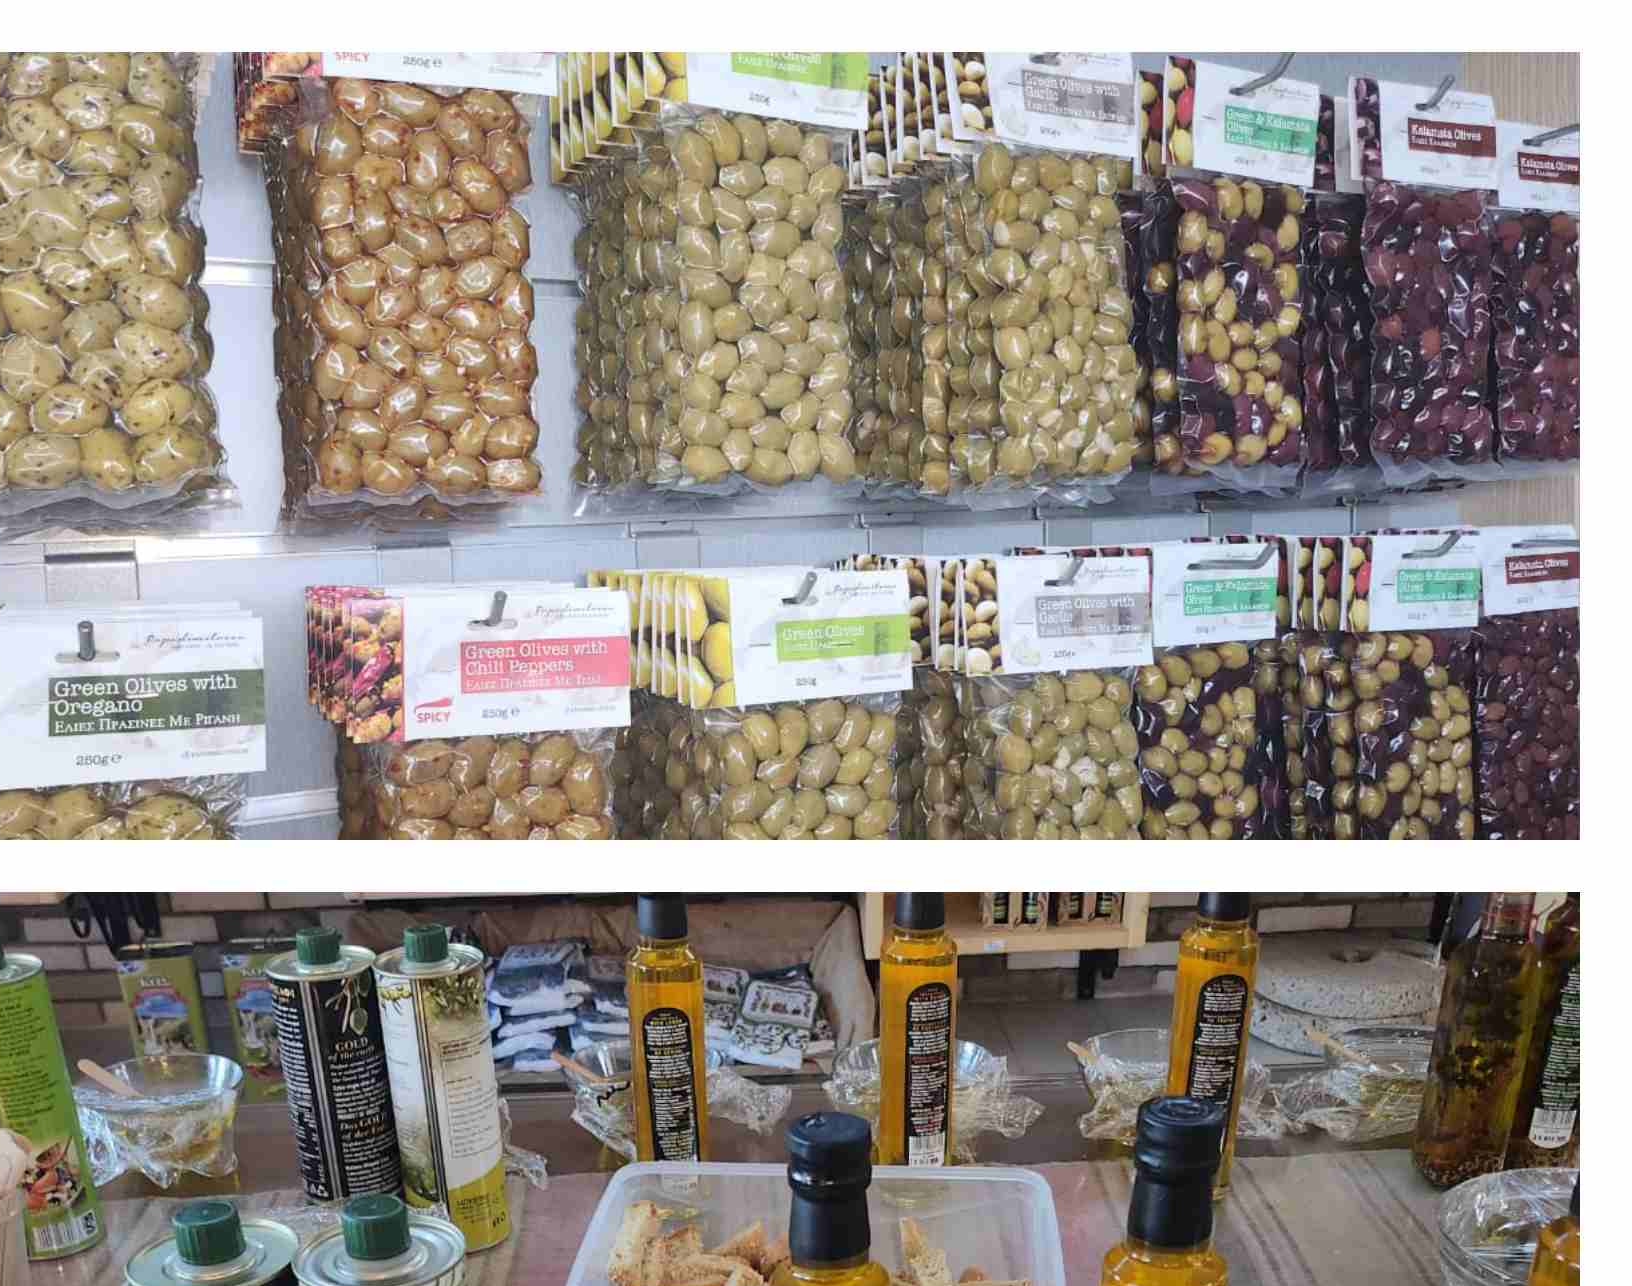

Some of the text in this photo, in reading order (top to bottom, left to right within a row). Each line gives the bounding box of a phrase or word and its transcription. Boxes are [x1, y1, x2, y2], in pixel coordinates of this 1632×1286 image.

[465, 640, 608, 660] Green Olives with
[465, 658, 575, 676] Chili Peppers
[54, 674, 238, 697] Green Olives with
[54, 699, 144, 718] Oregano
[417, 711, 450, 723] SPICY
[76, 754, 109, 767] 250g
[335, 1036, 368, 1053] GOLD
